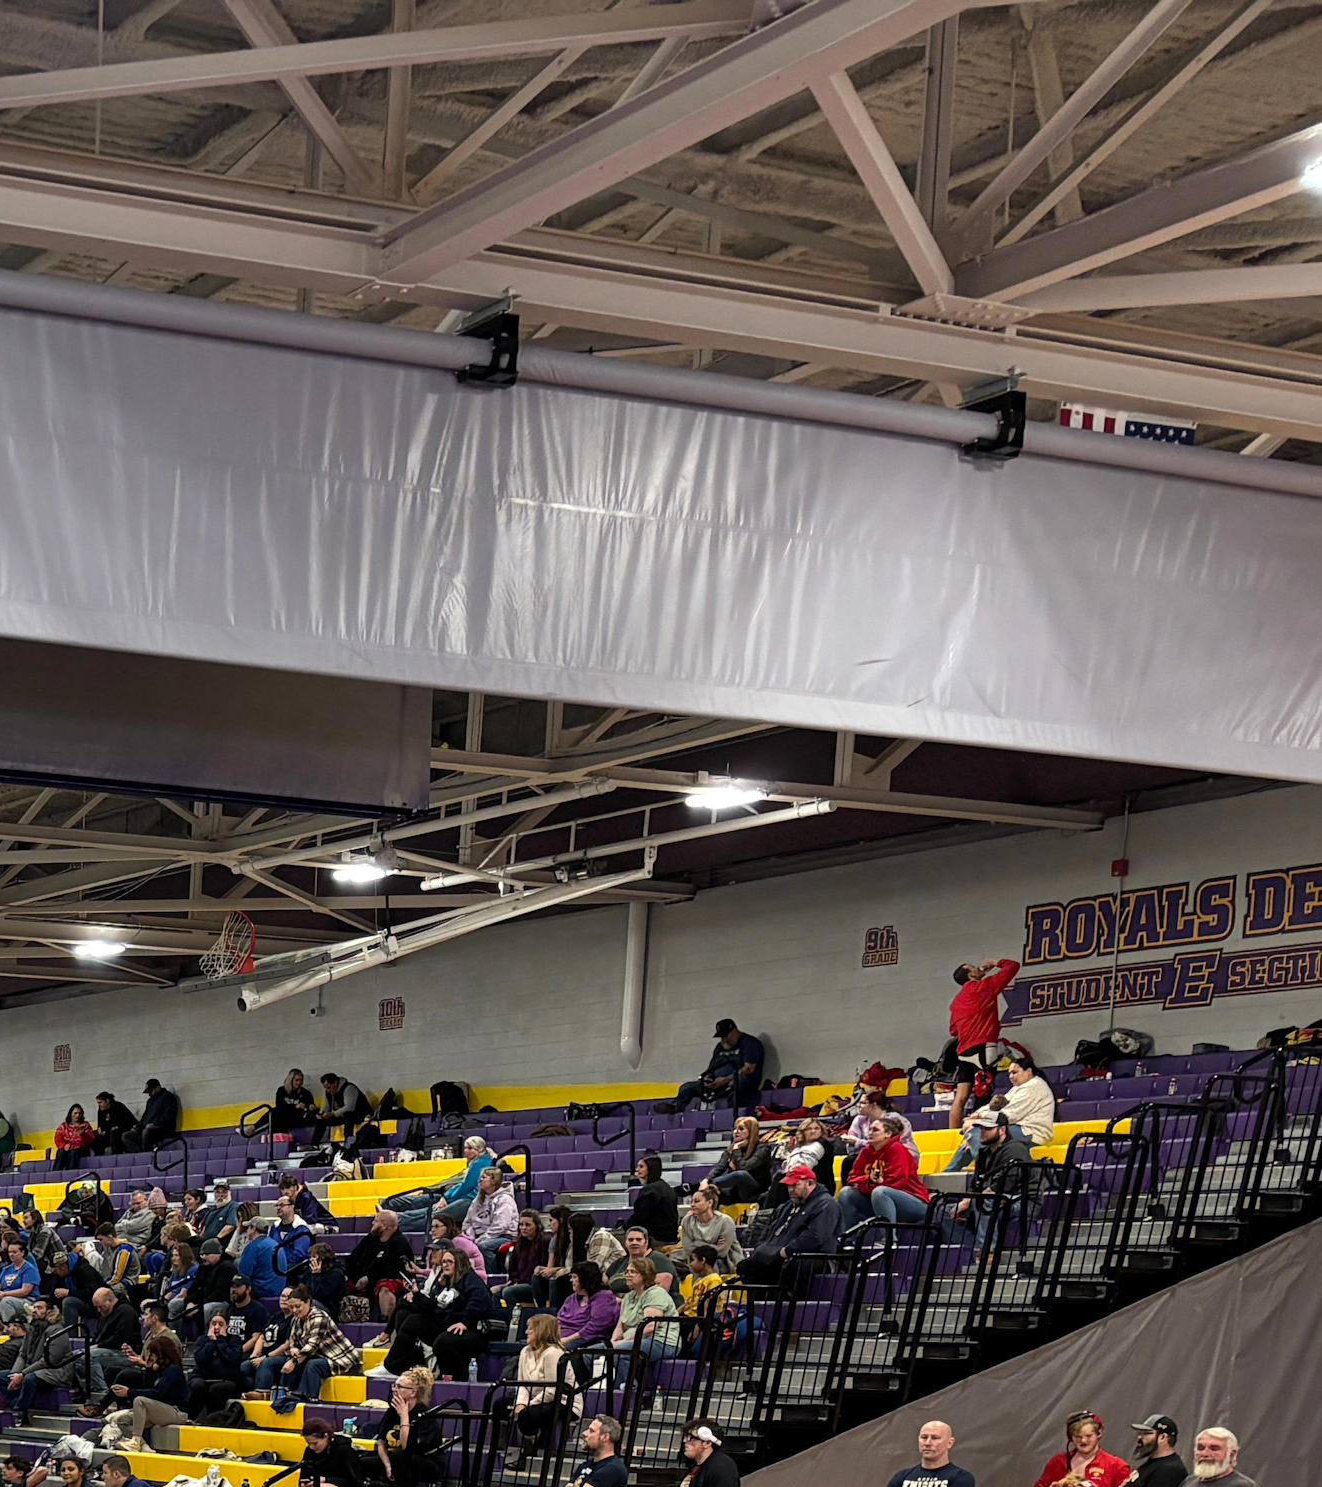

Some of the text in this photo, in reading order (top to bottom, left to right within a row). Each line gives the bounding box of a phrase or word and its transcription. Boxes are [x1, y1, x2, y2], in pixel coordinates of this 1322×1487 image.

[865, 926, 898, 951] 9th
[1023, 875, 1237, 966] ROYALS
[863, 951, 898, 966] GRADE
[1028, 948, 1322, 1013] STUDENT E SECTI
